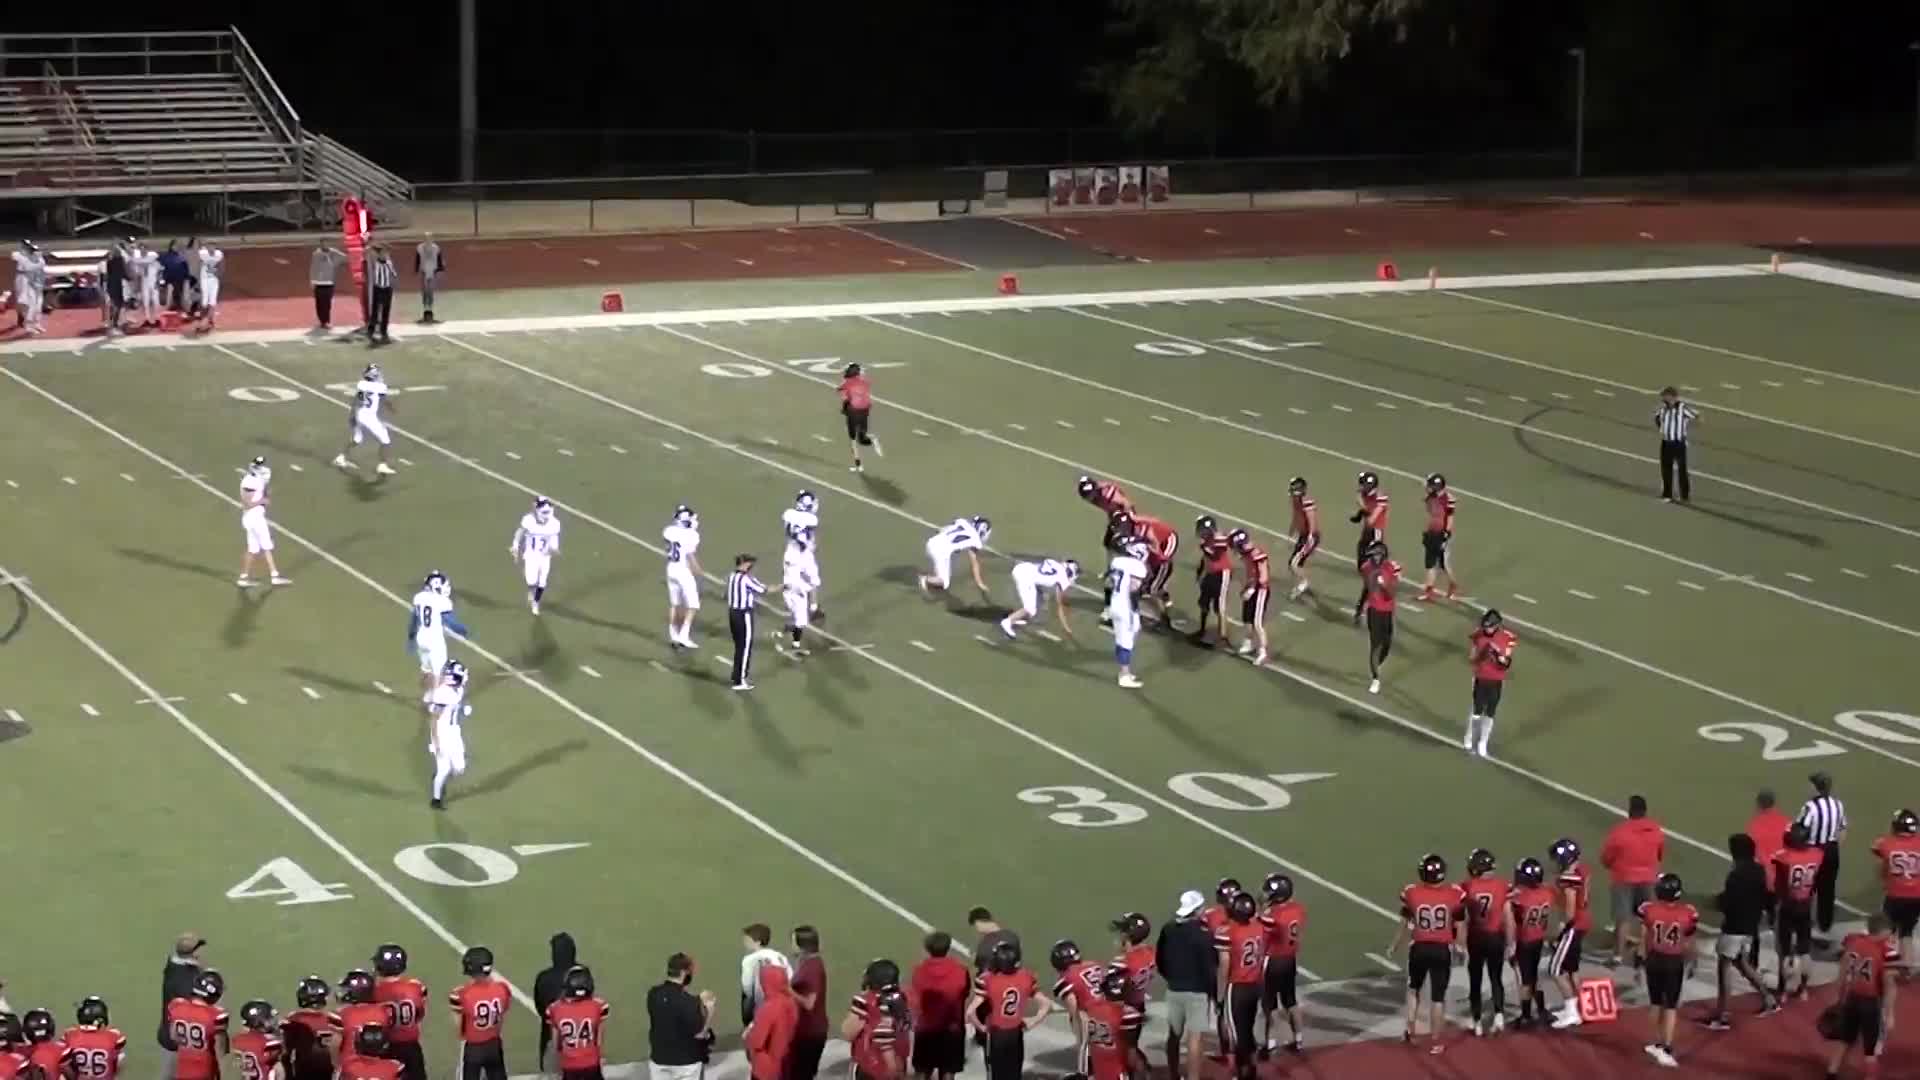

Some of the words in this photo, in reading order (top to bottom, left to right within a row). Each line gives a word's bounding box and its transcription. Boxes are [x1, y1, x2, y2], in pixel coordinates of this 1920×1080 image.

[1016, 772, 1291, 827] 30
[225, 842, 518, 906] 40
[1416, 903, 1450, 932] 69
[1475, 892, 1493, 920] 7
[1652, 920, 1682, 946] 14
[1001, 986, 1020, 1016] 2
[1583, 983, 1612, 1016] 30
[560, 1018, 593, 1049] 24
[71, 1048, 109, 1078] 26
